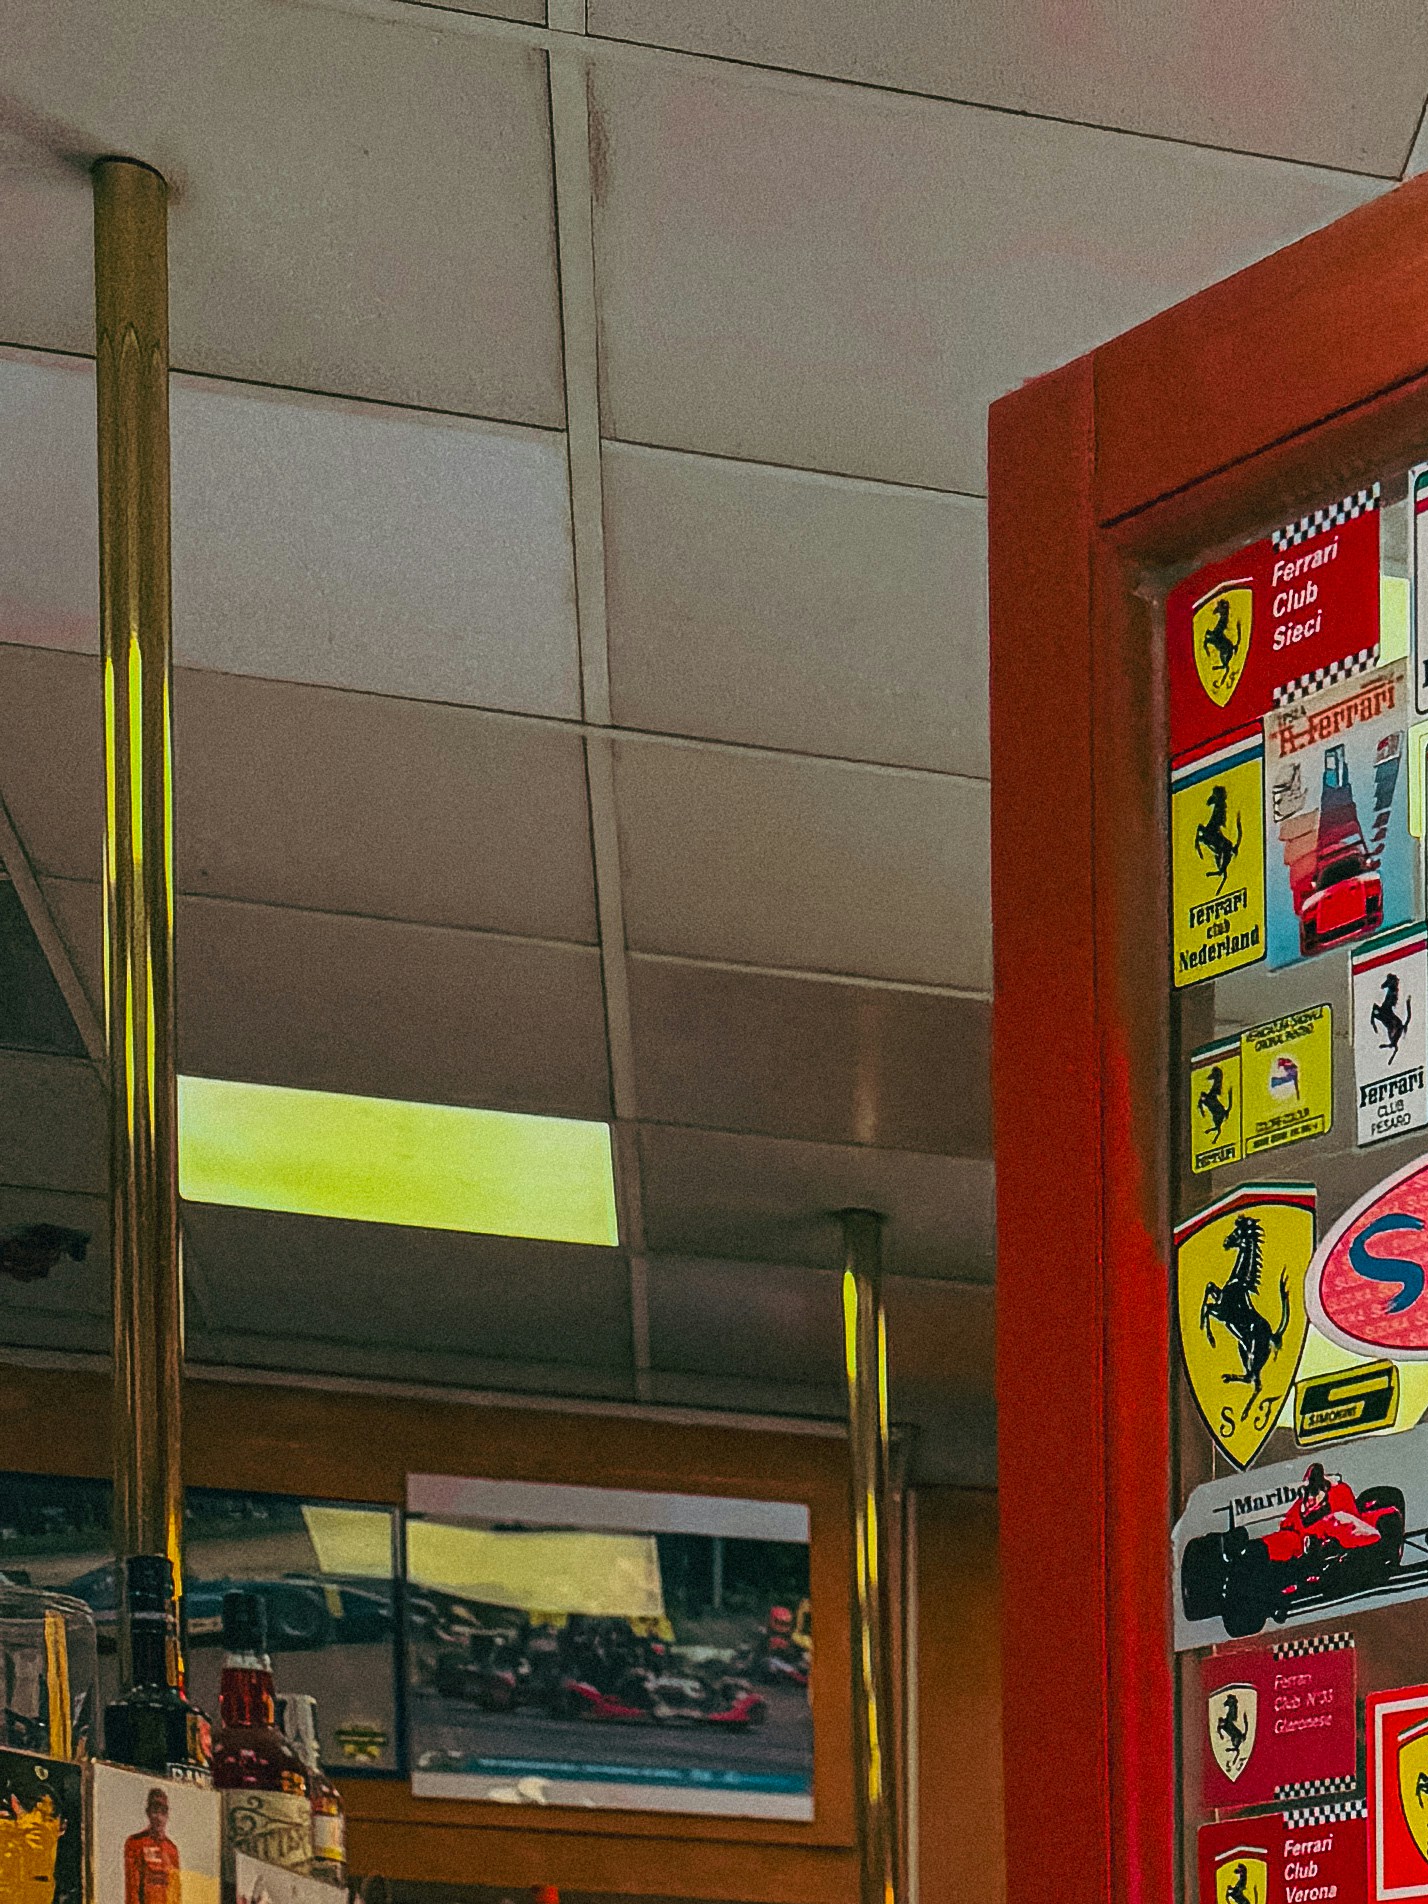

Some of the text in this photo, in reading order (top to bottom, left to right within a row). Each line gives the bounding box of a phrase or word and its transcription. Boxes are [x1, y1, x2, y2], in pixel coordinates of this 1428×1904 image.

[1273, 536, 1340, 584] Ferrari
[1273, 580, 1319, 617] Club
[1273, 611, 1321, 651] Sieci
[1189, 888, 1249, 928] Ferrari
[1208, 918, 1230, 938] club
[1179, 925, 1259, 973] Nederland
